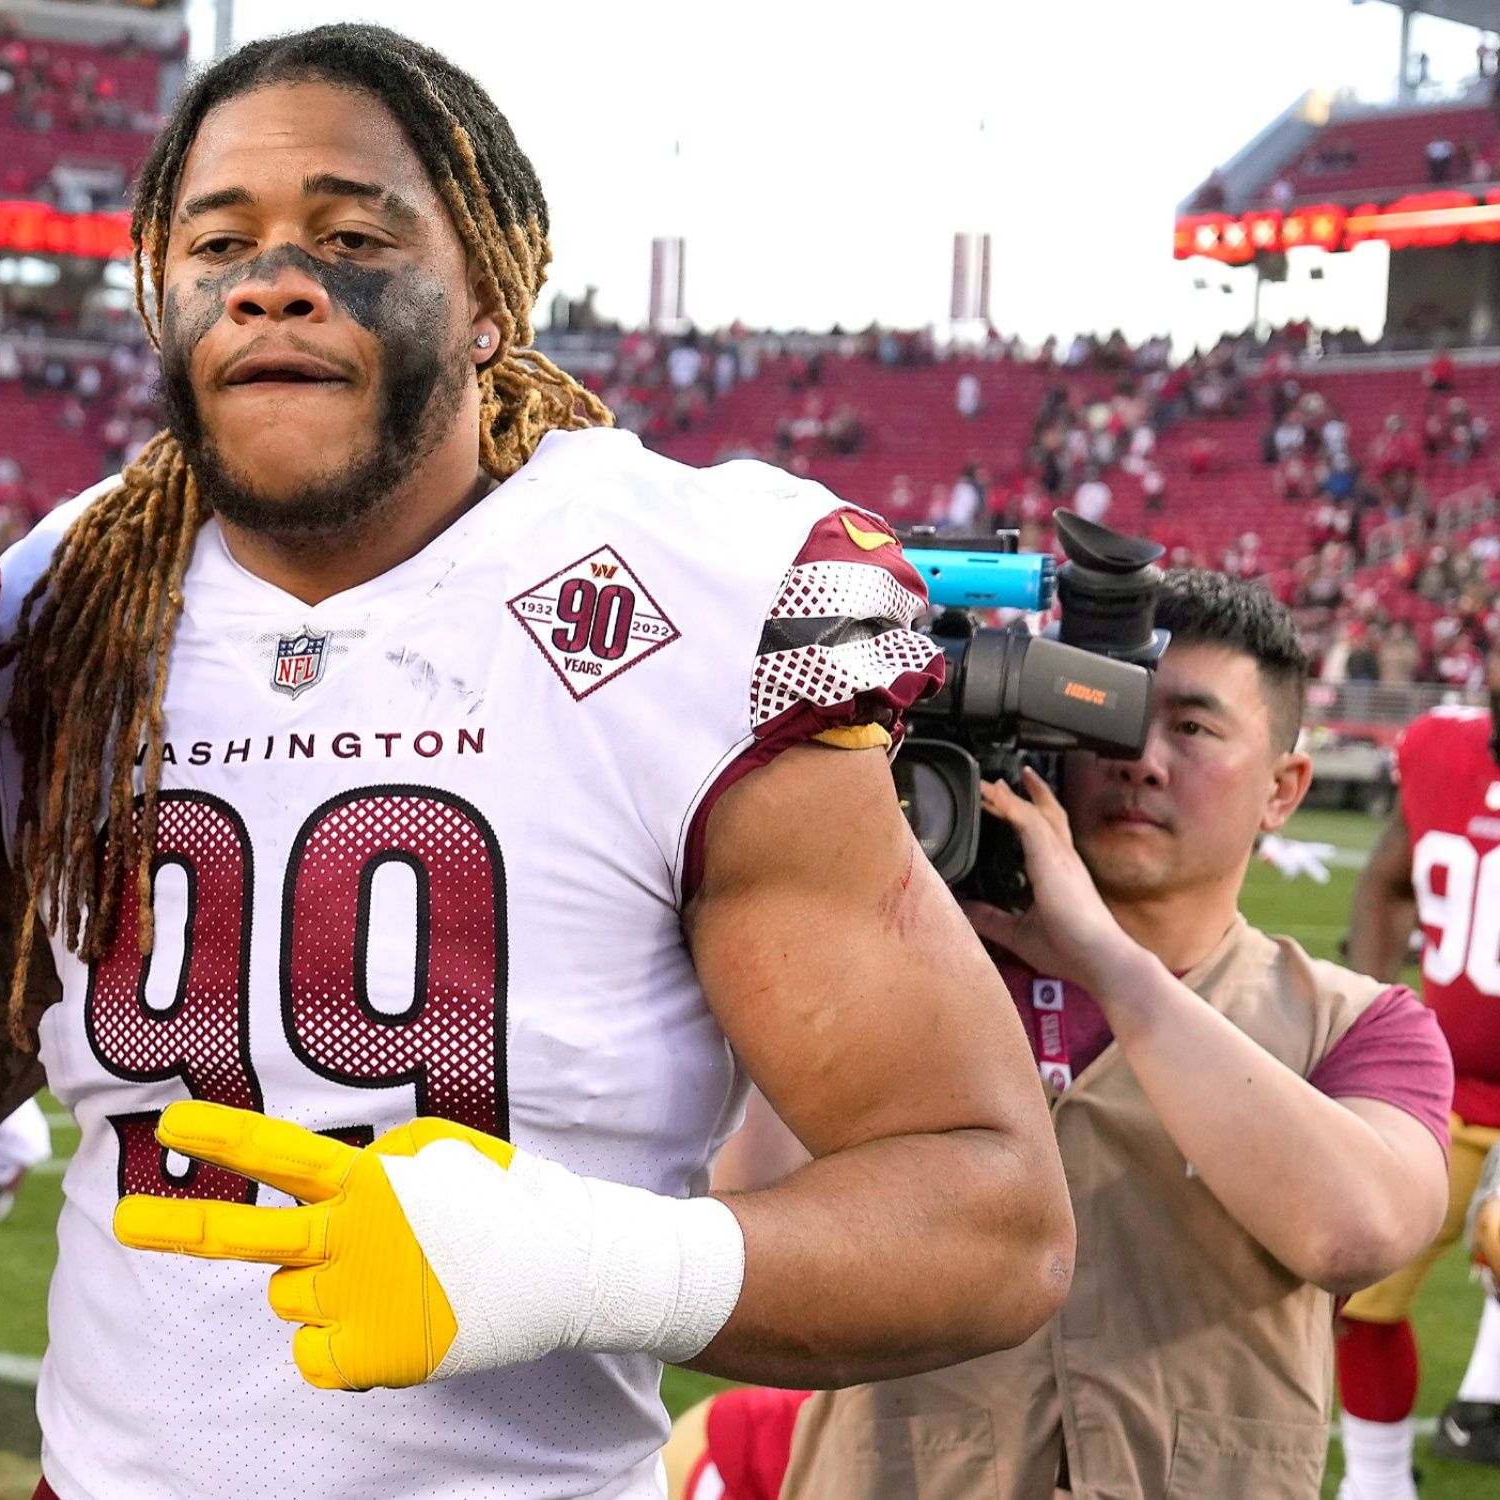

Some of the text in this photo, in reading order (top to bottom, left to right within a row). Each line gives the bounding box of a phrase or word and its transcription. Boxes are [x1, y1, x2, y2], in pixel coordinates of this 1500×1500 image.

[520, 601, 553, 616] 1932
[551, 578, 636, 661] 90
[632, 621, 669, 637] 2022
[277, 656, 316, 686] NFL
[564, 656, 603, 677] YEARS
[84, 783, 510, 1207] 99
